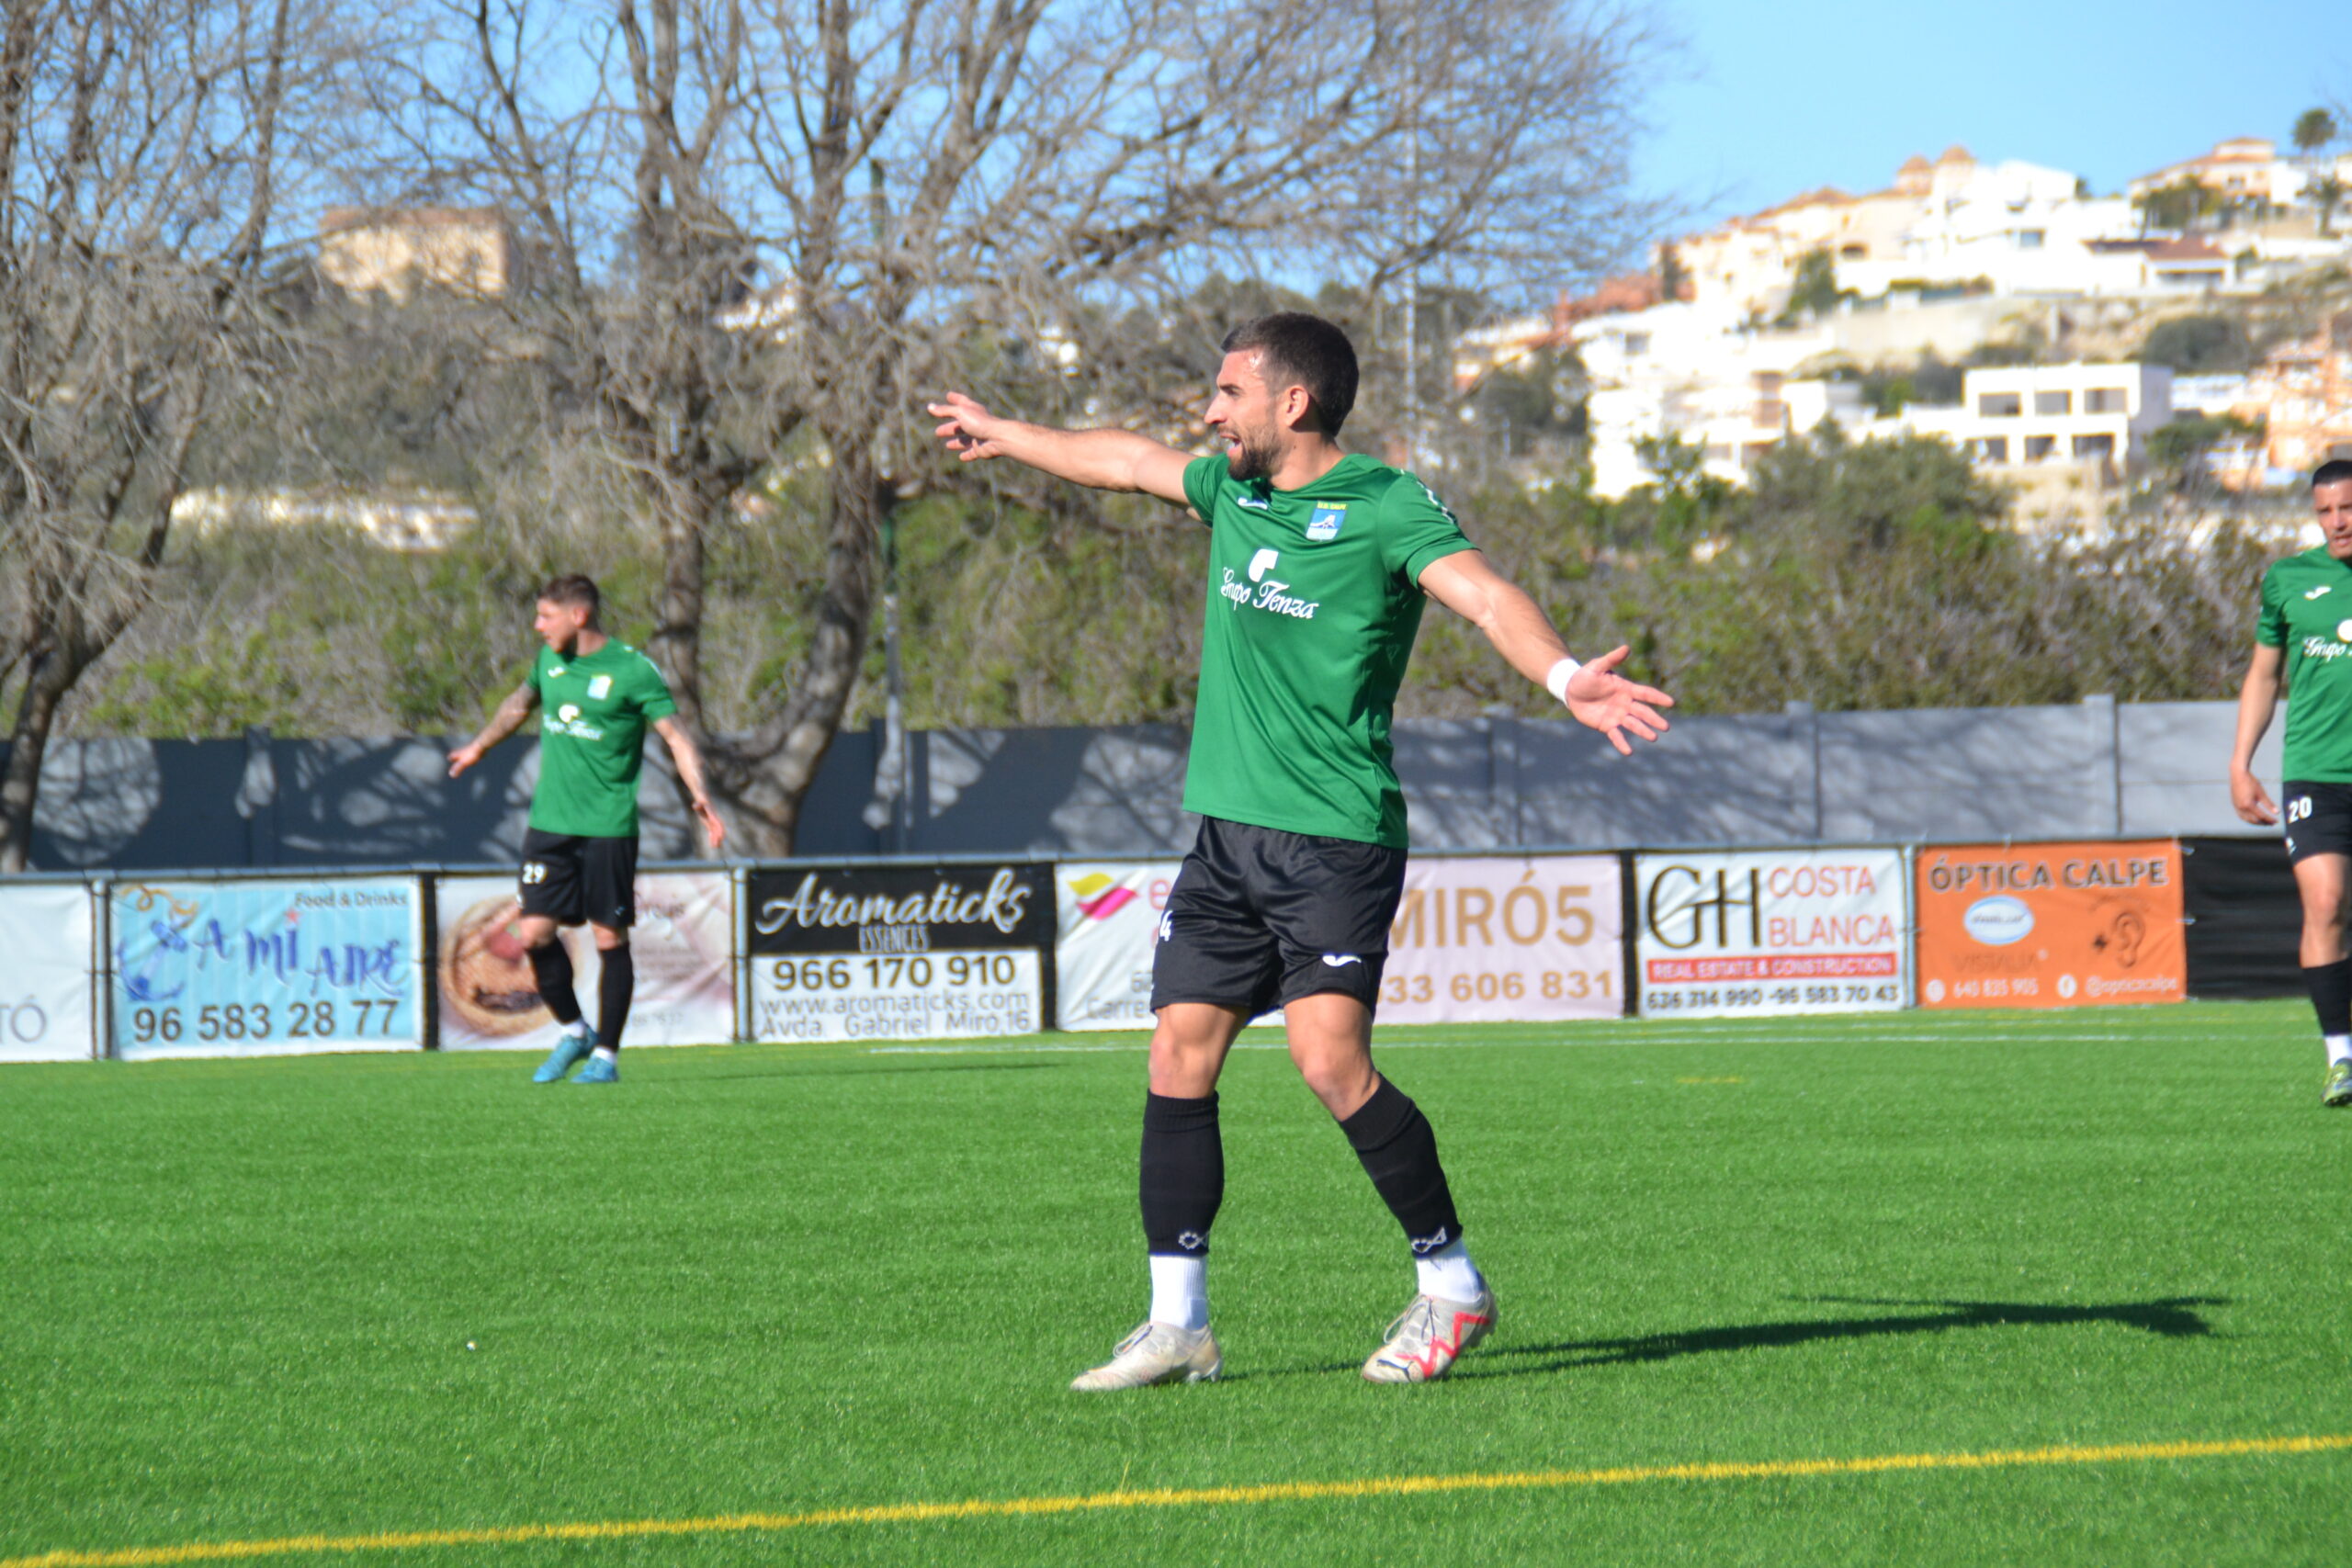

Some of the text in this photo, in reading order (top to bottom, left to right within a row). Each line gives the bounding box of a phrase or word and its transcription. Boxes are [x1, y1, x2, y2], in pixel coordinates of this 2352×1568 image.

[1252, 581, 1319, 619] Tenza
[2289, 795, 2312, 824] 20
[523, 863, 547, 884] 29
[1928, 853, 2169, 893] ÓPTICA CALPE
[294, 892, 335, 908] Food
[356, 890, 408, 907] Drinks
[755, 867, 1032, 935] Aromaticks
[1389, 869, 1595, 949] MIRÓ5
[1647, 864, 1875, 950] GH COSTA
[859, 924, 931, 953] ESSENCES
[1768, 915, 1896, 948] BLANCA
[773, 954, 1016, 991] 966 170 910
[1653, 962, 1694, 978] REAL
[1697, 960, 1754, 977] ESTATE
[1771, 955, 1893, 976] CONSTRUCTION
[760, 990, 1030, 1015] www.aromaticks.com
[1377, 969, 1612, 1005] 33 606 831
[1724, 987, 1764, 1006] 990
[1845, 984, 1871, 1001] 70
[134, 998, 398, 1042] 96 583 28 77
[843, 1011, 933, 1037] Gabriel
